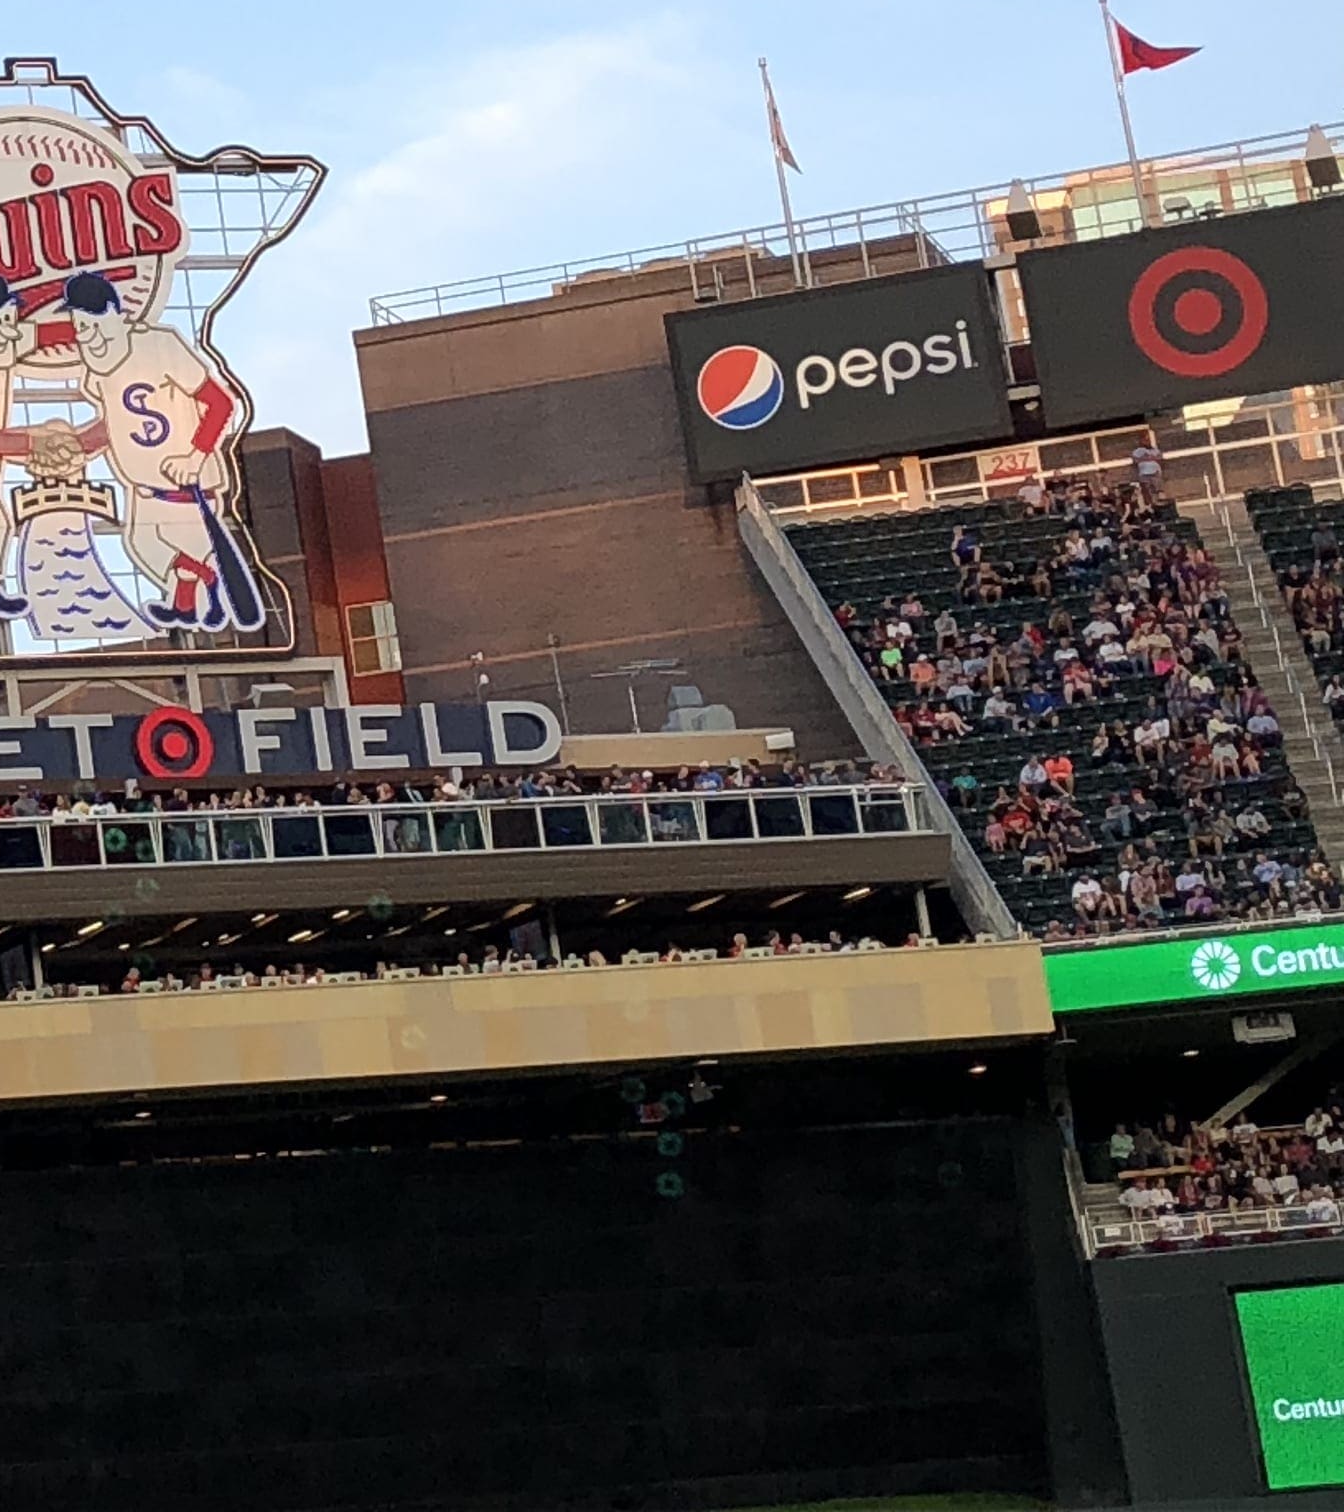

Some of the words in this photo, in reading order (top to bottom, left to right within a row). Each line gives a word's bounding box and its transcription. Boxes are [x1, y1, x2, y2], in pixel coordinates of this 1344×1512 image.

[796, 319, 976, 409] pepsi
[992, 452, 1030, 474] 237
[239, 700, 563, 773] FIELD
